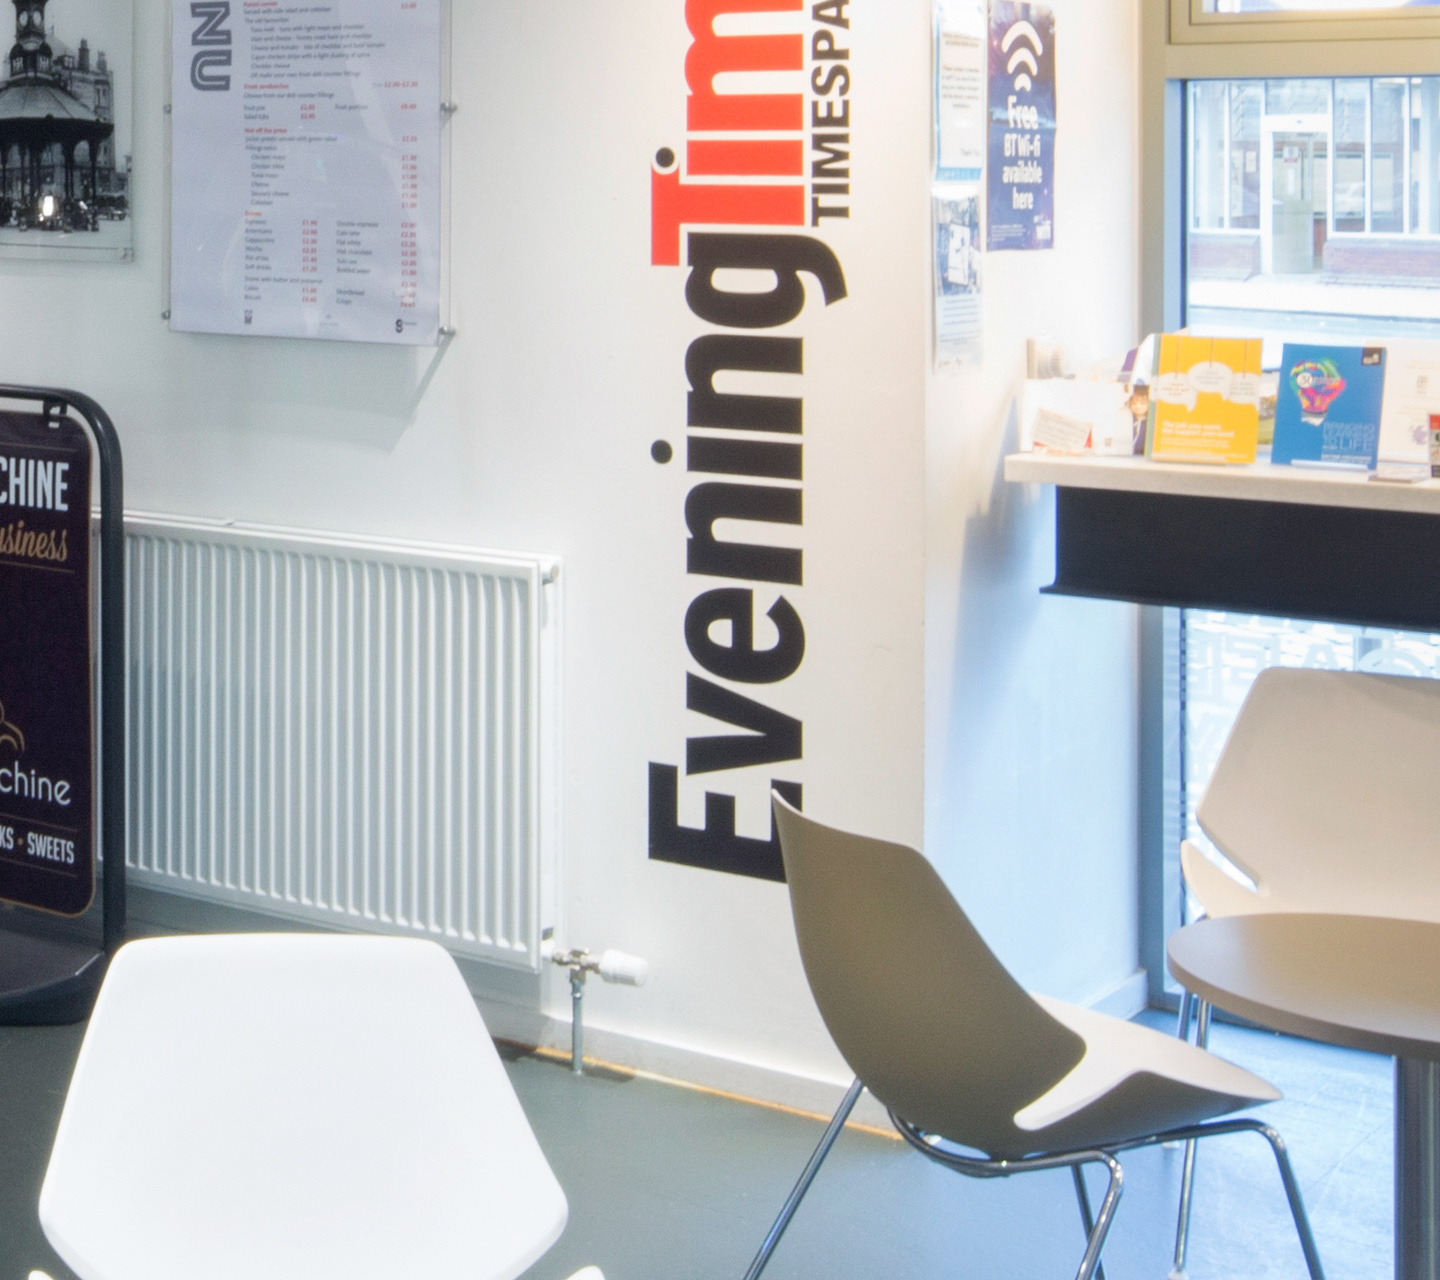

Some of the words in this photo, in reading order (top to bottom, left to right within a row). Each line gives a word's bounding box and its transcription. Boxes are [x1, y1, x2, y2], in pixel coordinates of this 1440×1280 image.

[1007, 95, 1039, 129] Free
[1004, 134, 1016, 157] BT
[1017, 133, 1041, 157] Wi-fi
[1002, 160, 1043, 184] available
[1012, 186, 1034, 210] here
[1340, 438, 1372, 452] LIFE
[27, 832, 75, 864] SWEETS
